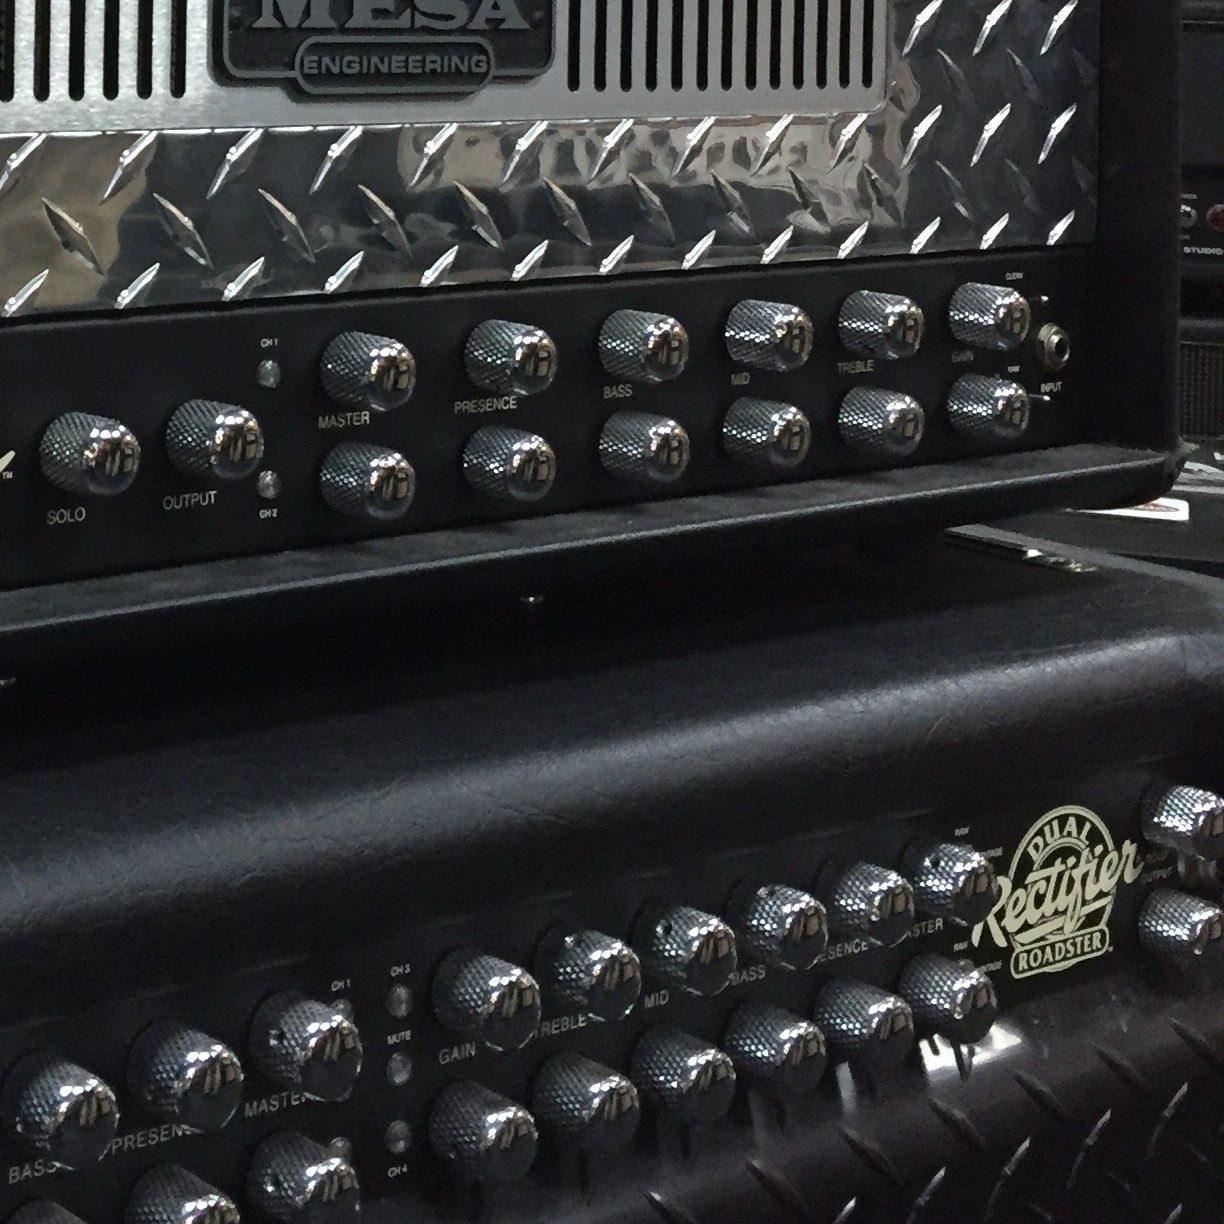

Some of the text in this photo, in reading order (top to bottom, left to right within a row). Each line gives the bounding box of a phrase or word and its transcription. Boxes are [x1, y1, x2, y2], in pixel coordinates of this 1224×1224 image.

[303, 55, 490, 75] ENGINEERING
[260, 337, 272, 349] CH
[837, 359, 874, 374] TREBLE
[731, 372, 751, 385] MID
[1040, 381, 1063, 394] INPUT
[603, 383, 633, 399] BASS
[454, 395, 518, 415] PRESENCE
[318, 410, 370, 429] MASTER
[162, 490, 217, 511] OUTPUT
[46, 506, 86, 526] SOLO
[259, 508, 271, 519] CH
[1026, 815, 1093, 863] DUAL
[971, 839, 1144, 949] Rectifier
[907, 917, 944, 938] STER
[1018, 932, 1103, 972] ROADSTER
[390, 965, 404, 978] CH
[729, 964, 766, 986] BASS
[330, 980, 344, 992] CH
[643, 990, 670, 1009] MID
[534, 1013, 588, 1038] REBLE
[387, 1029, 412, 1045] MUTE
[438, 1041, 477, 1065] GAIN
[244, 1090, 306, 1118] MASTE
[111, 1123, 188, 1156] PRESEN
[387, 1166, 401, 1178] CH
